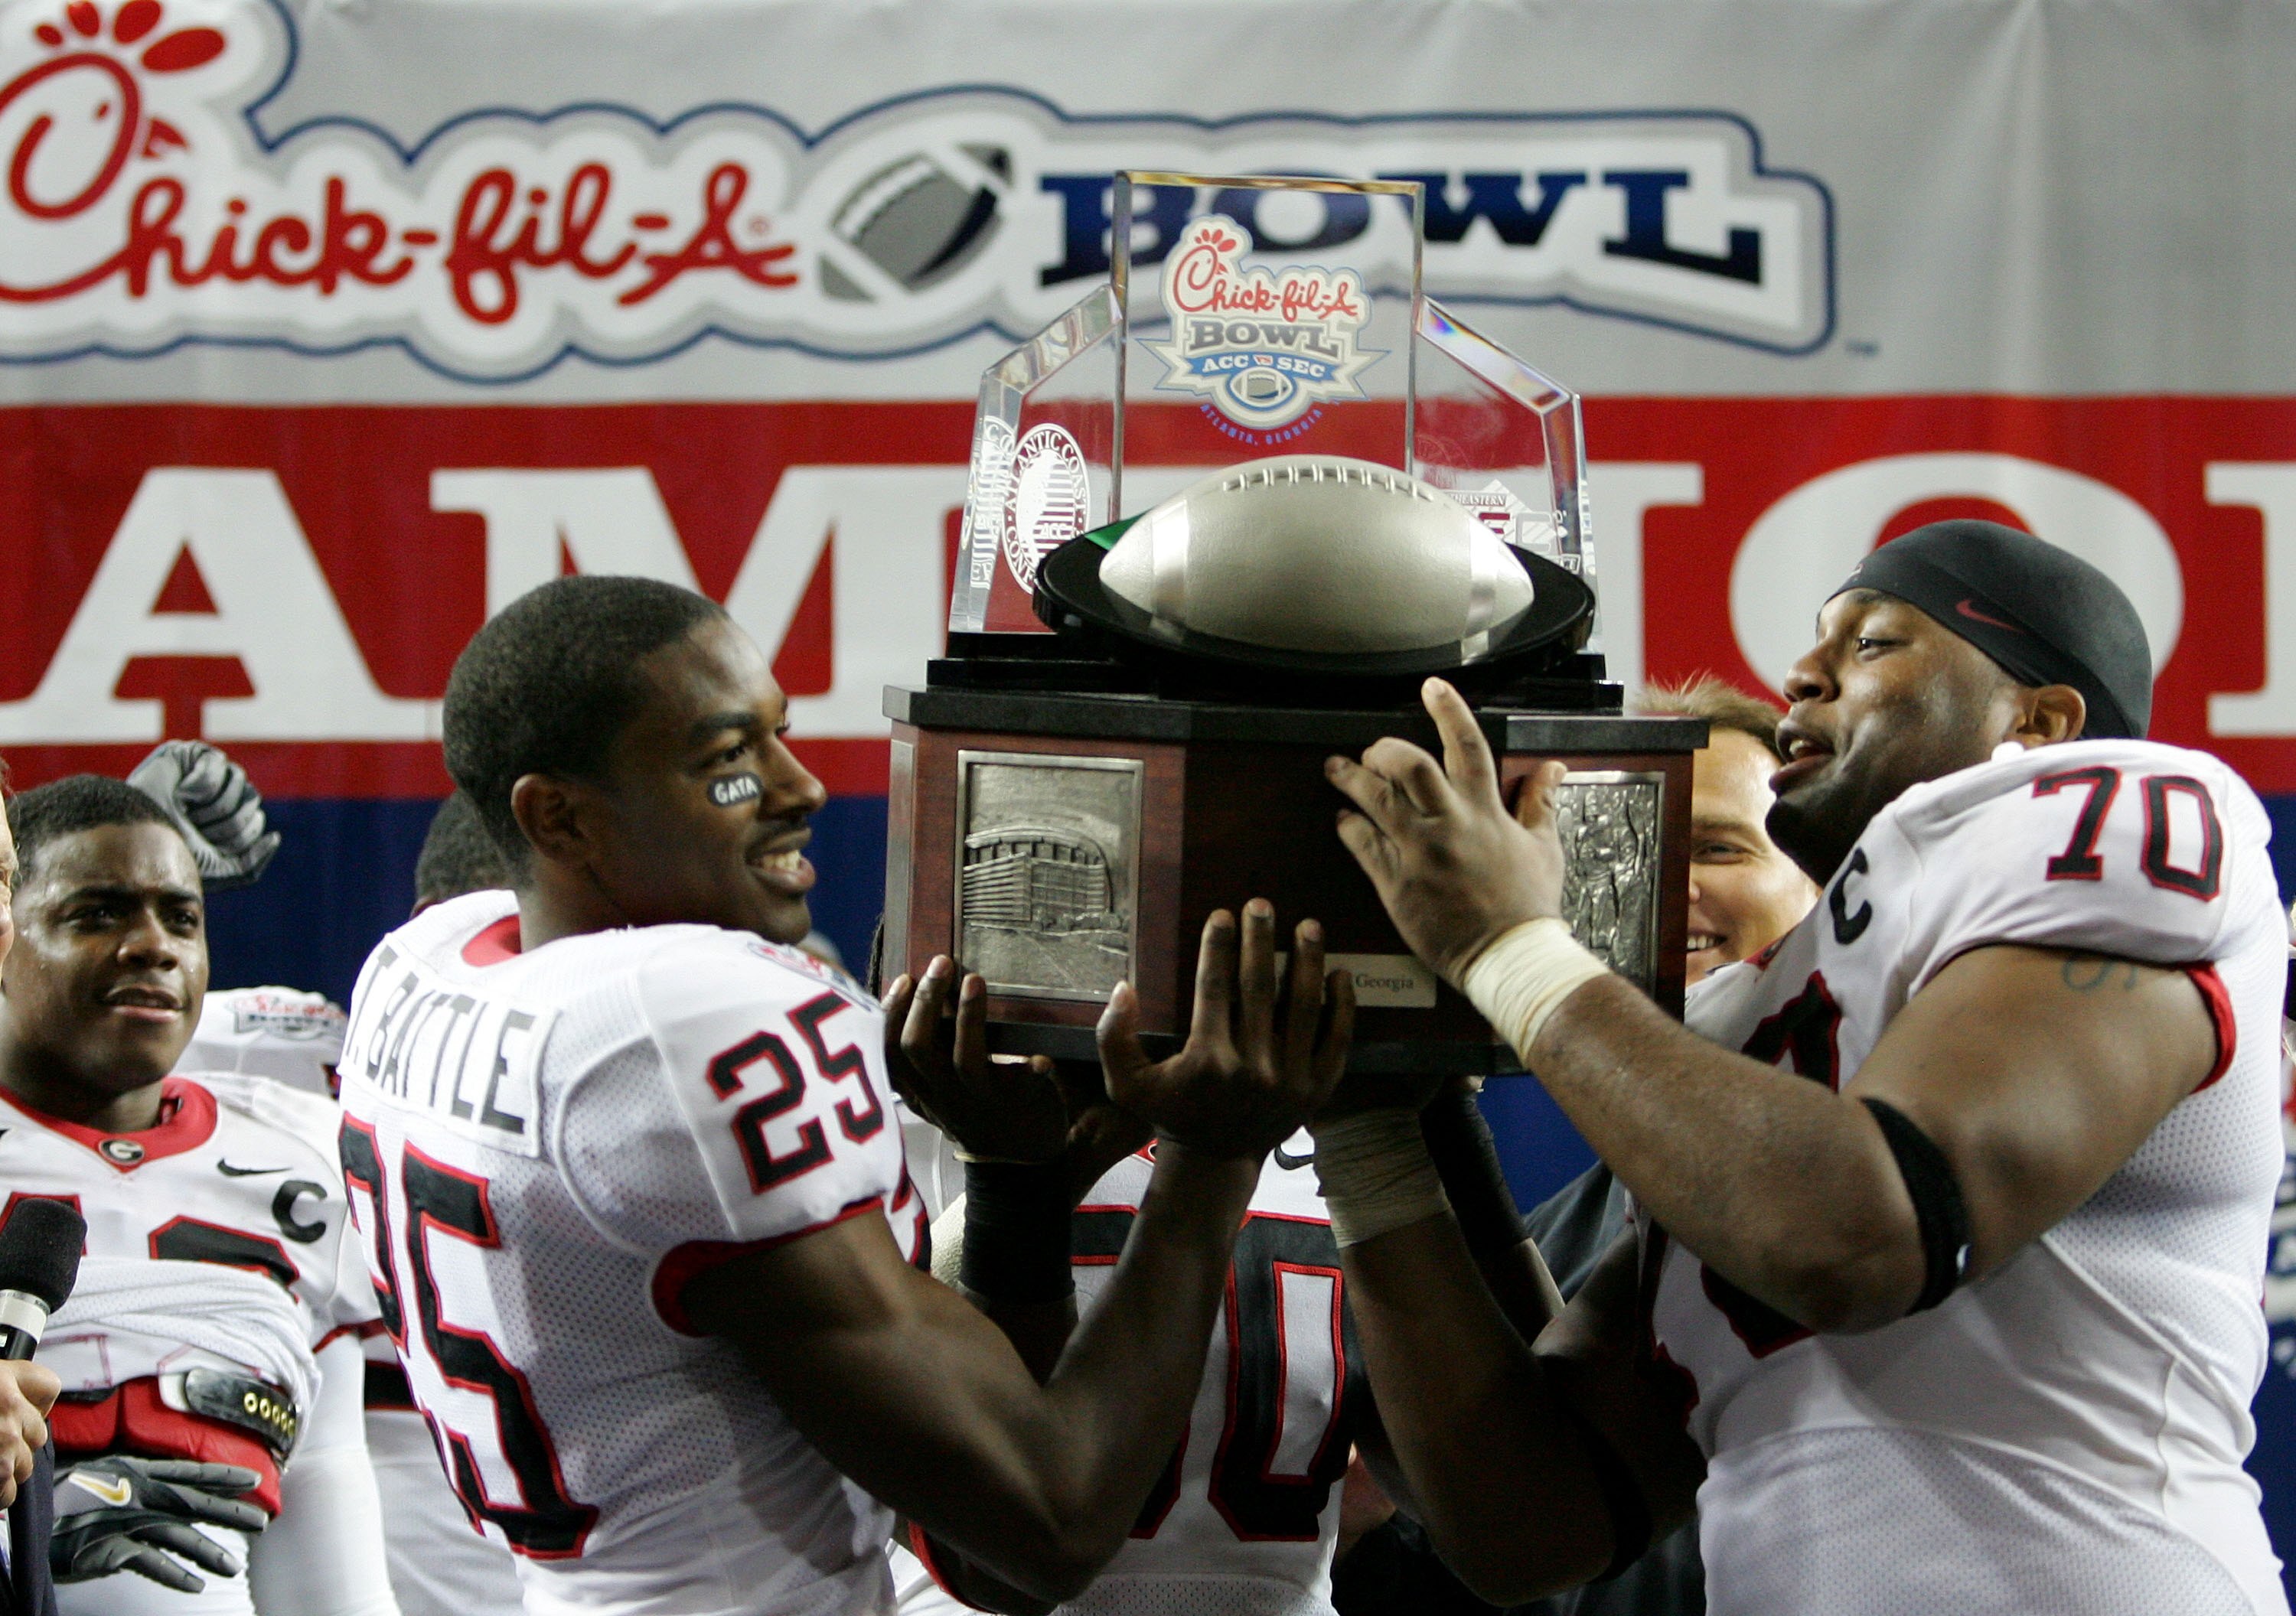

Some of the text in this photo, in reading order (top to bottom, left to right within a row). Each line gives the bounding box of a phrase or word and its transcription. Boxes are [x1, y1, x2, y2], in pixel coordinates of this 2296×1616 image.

[0, 52, 1763, 324] Chick-fil-A BOWL
[1173, 245, 1358, 322] Chick-fil-A
[1189, 320, 1339, 358] BOWL
[1202, 354, 1249, 373] ACC
[1277, 357, 1326, 377] SEC
[1005, 430, 1063, 513] ATLANTIC
[1061, 442, 1087, 511] COAST
[2032, 765, 2223, 903] 70
[1828, 846, 1874, 946] C
[706, 991, 883, 1196] 25
[271, 1179, 328, 1244] C
